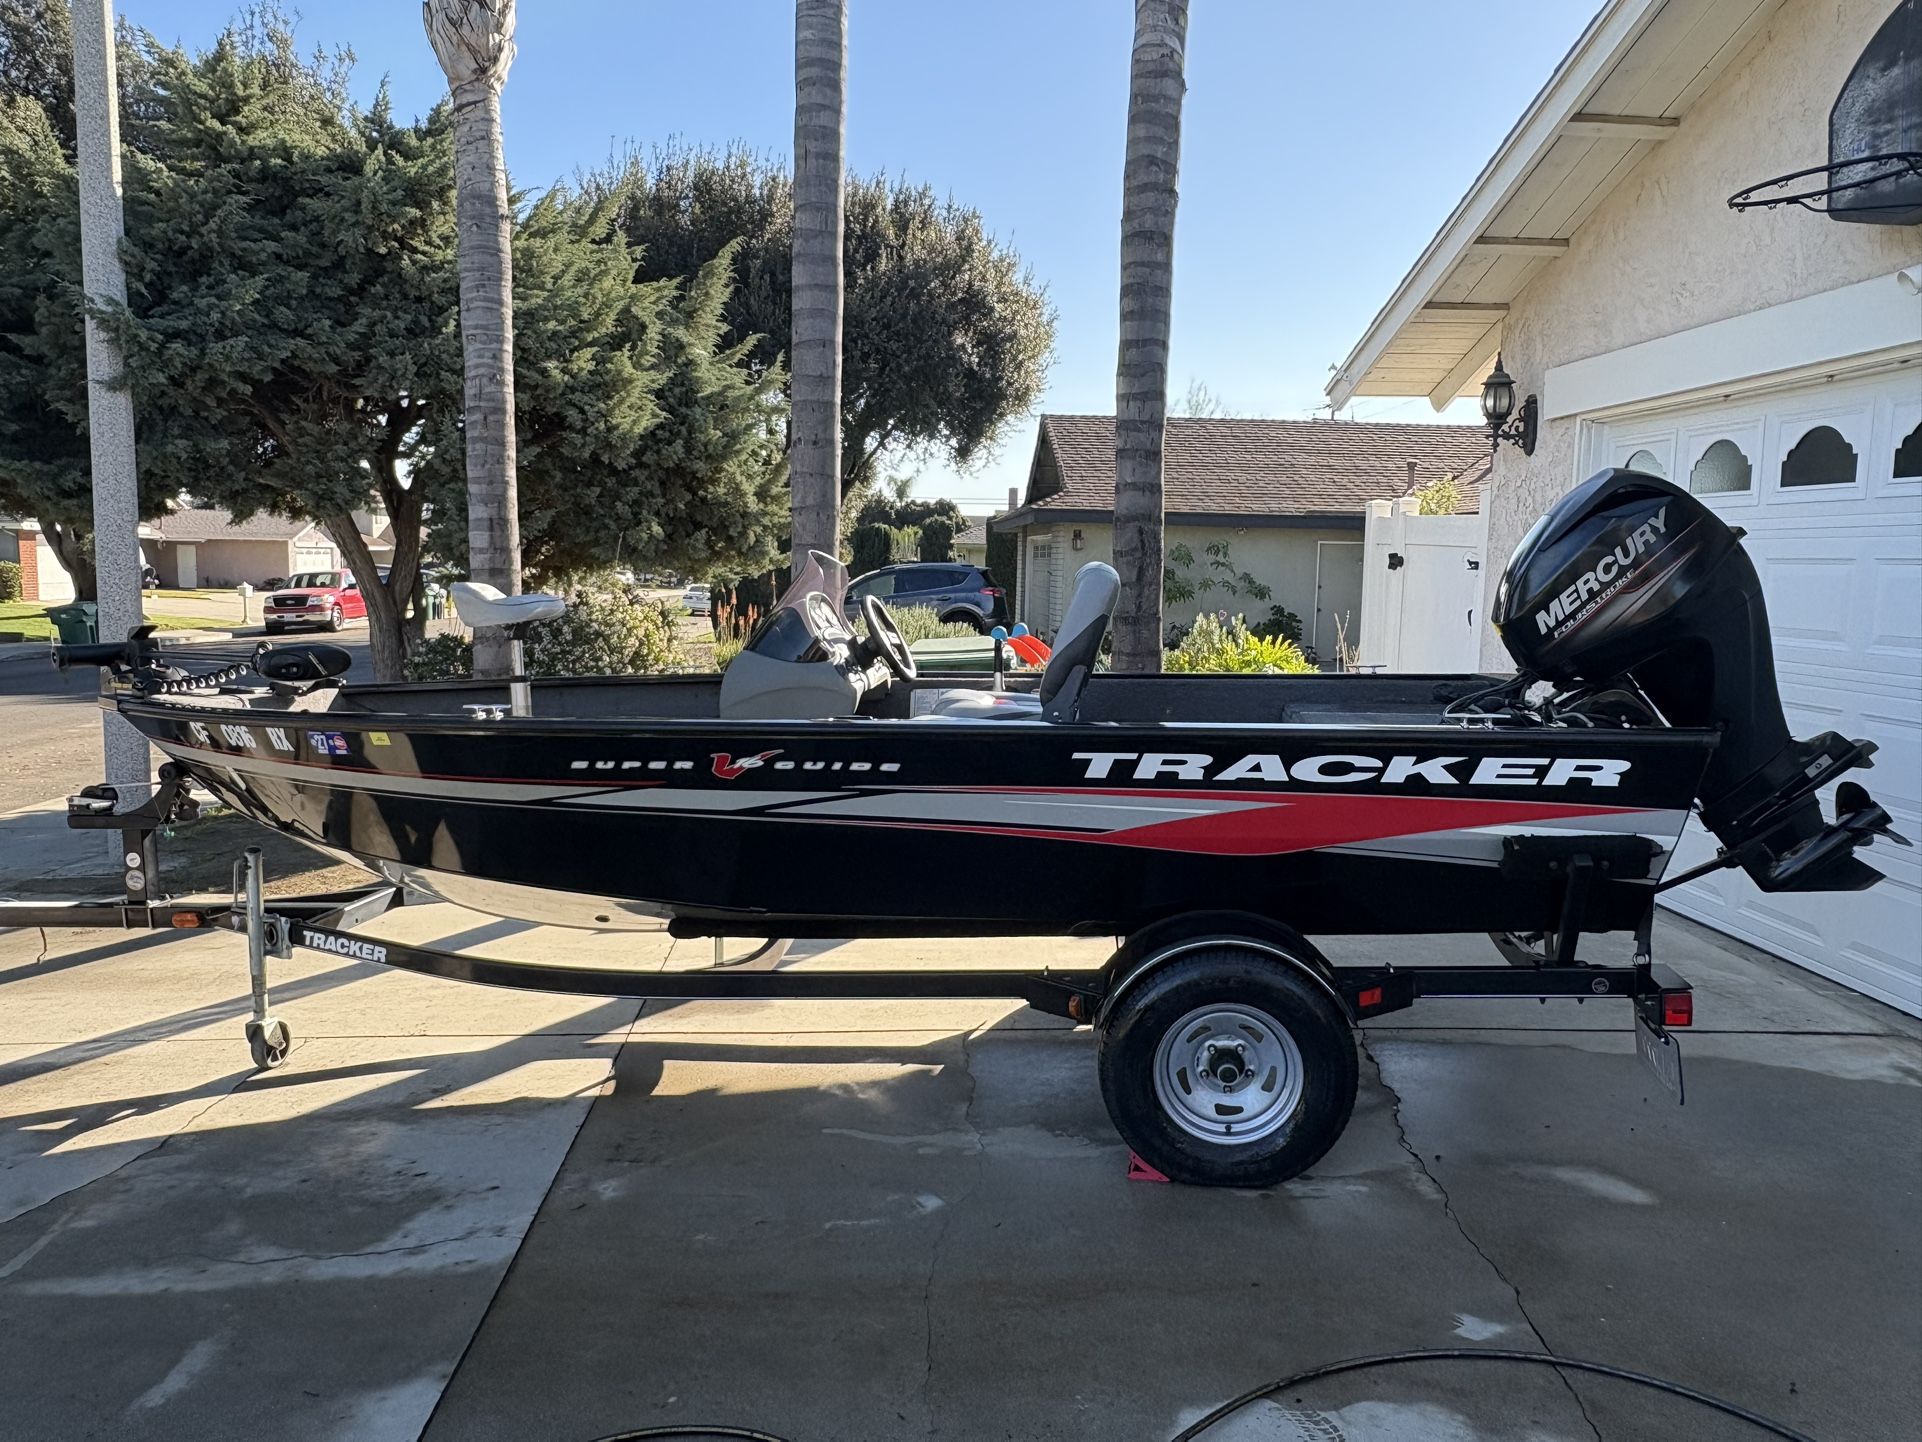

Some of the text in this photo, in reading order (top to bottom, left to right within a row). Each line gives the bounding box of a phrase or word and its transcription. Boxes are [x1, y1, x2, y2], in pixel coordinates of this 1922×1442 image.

[1535, 506, 1667, 635] MERCURY
[1554, 568, 1636, 639] FOURSTROKE
[220, 724, 257, 748] 0816
[265, 727, 295, 751] RX
[570, 761, 694, 769] SUPER
[773, 761, 901, 771] GUIDE
[1071, 752, 1632, 787] TRACKER
[303, 930, 386, 962] TRACKER
